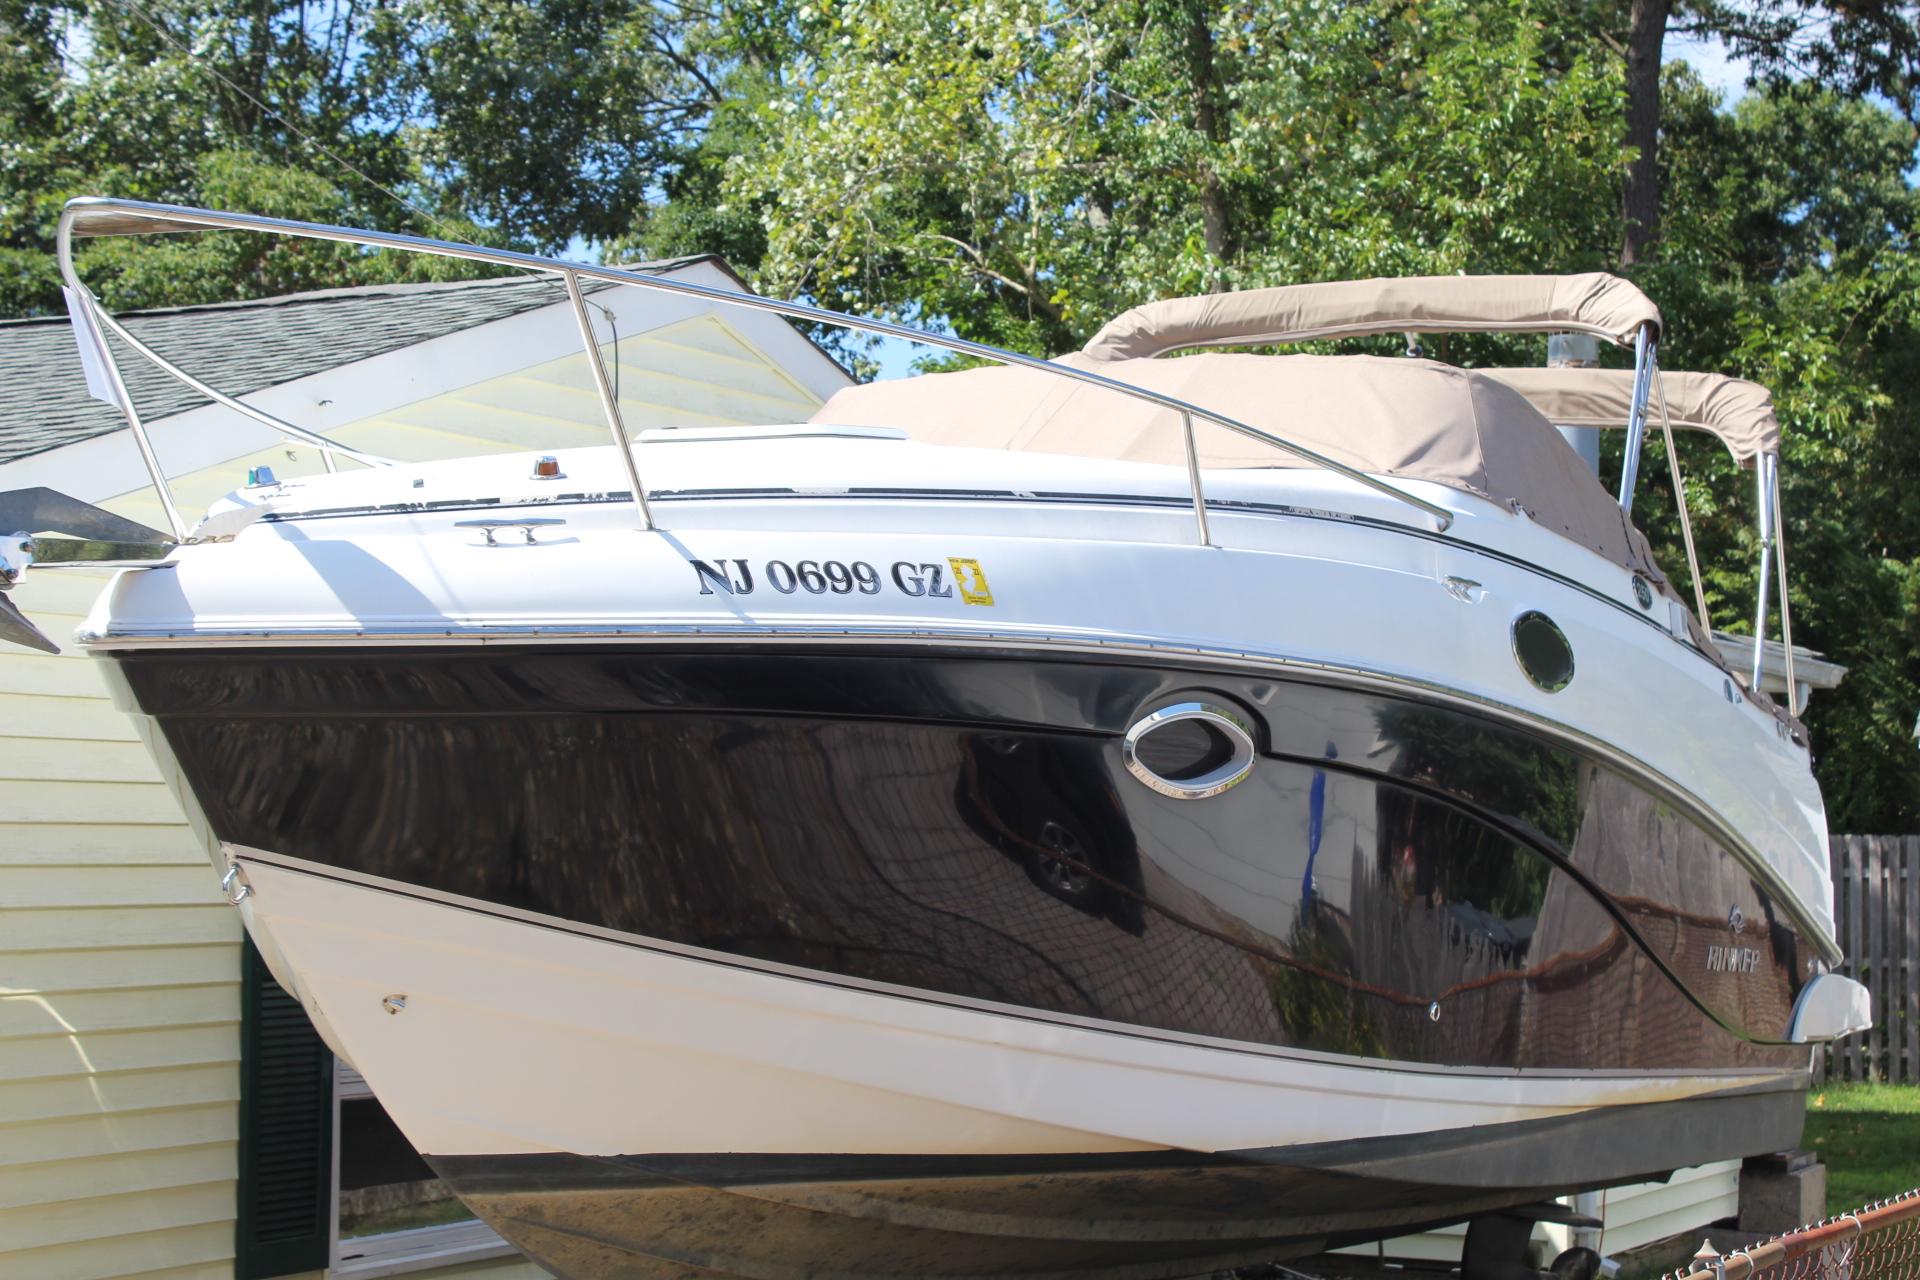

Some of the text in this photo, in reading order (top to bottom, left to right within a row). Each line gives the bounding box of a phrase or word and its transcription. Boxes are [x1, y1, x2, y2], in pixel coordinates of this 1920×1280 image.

[689, 559, 953, 598] NJ 0699 GZ
